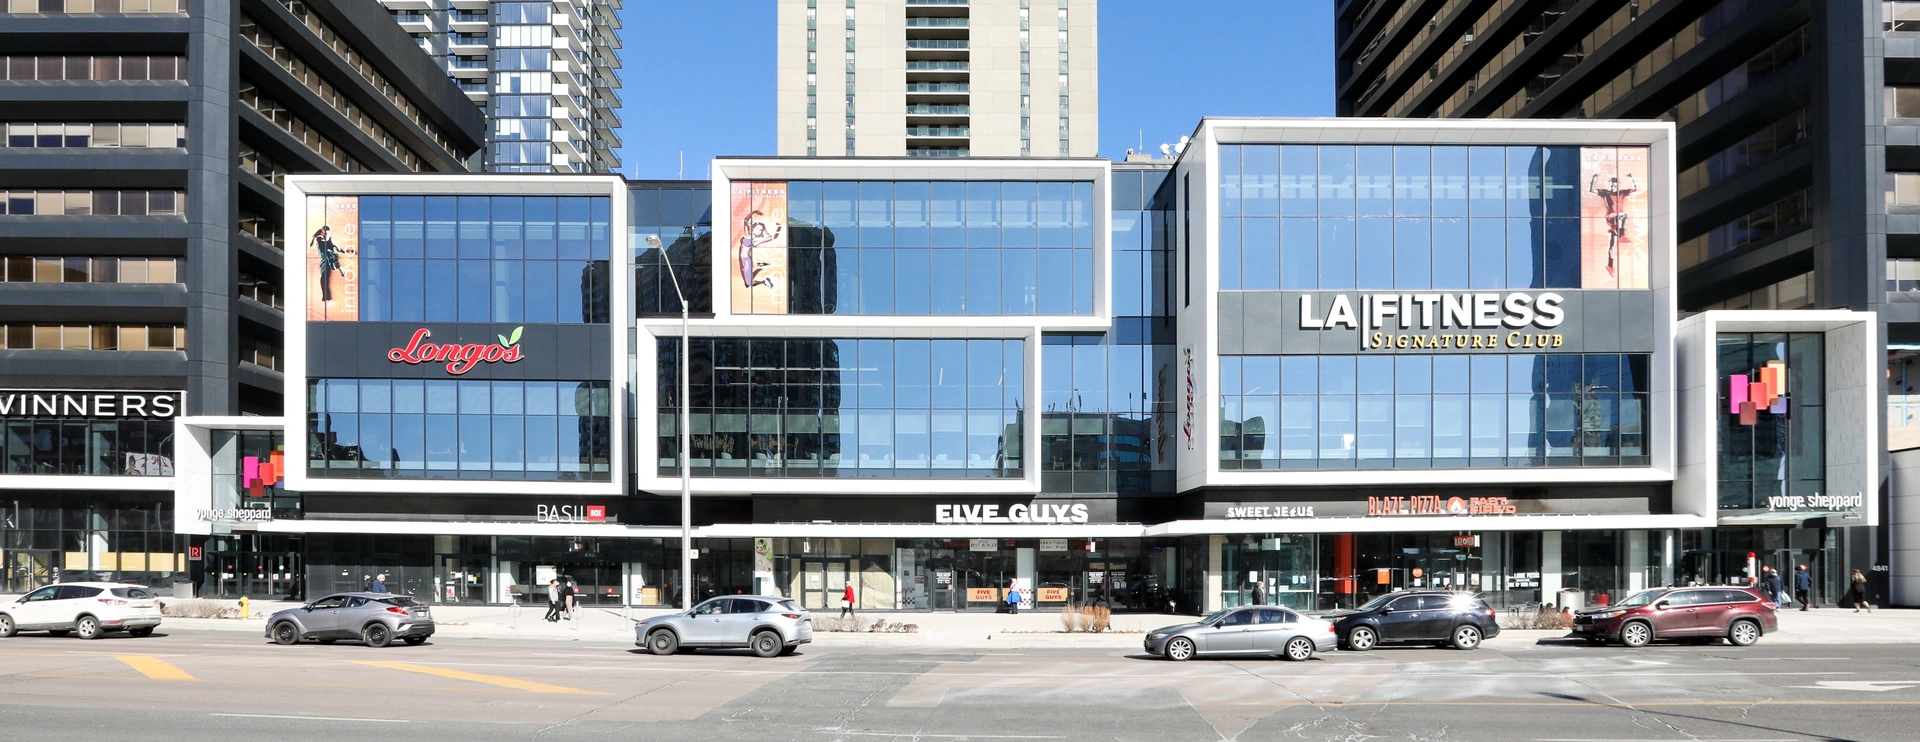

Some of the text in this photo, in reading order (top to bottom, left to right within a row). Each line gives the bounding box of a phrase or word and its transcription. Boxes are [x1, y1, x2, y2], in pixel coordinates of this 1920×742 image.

[1300, 292, 1565, 329] LA FITNESS
[1371, 331, 1564, 349] SIGNATURE CLUB
[1368, 495, 1442, 514] BLAZE PIZZA
[1767, 492, 1862, 511] yonge sheppard
[197, 507, 272, 520] yonge sheppard
[537, 504, 602, 523] BASIL BOX
[1008, 503, 1089, 523] GUYS
[1227, 506, 1271, 517] SWEET
